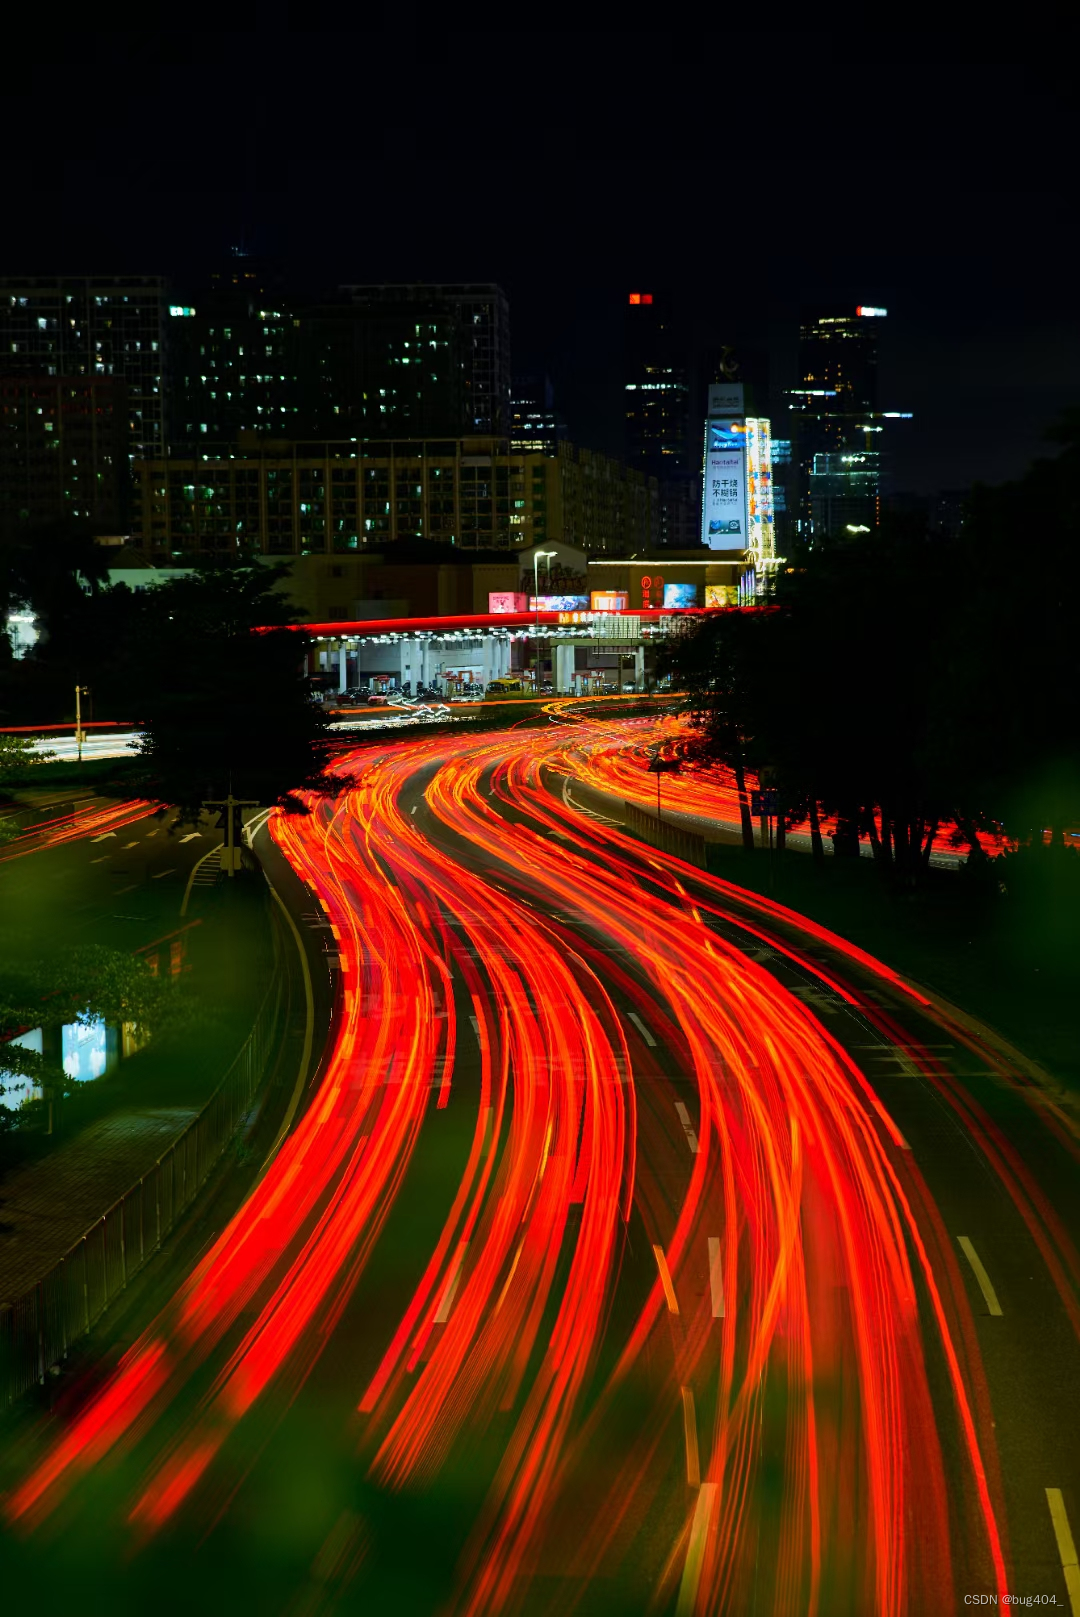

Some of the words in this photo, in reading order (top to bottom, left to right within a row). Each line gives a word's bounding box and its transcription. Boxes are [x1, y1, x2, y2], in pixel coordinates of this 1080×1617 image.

[712, 479, 738, 488] 防干烧
[712, 488, 738, 498] 不糊锅
